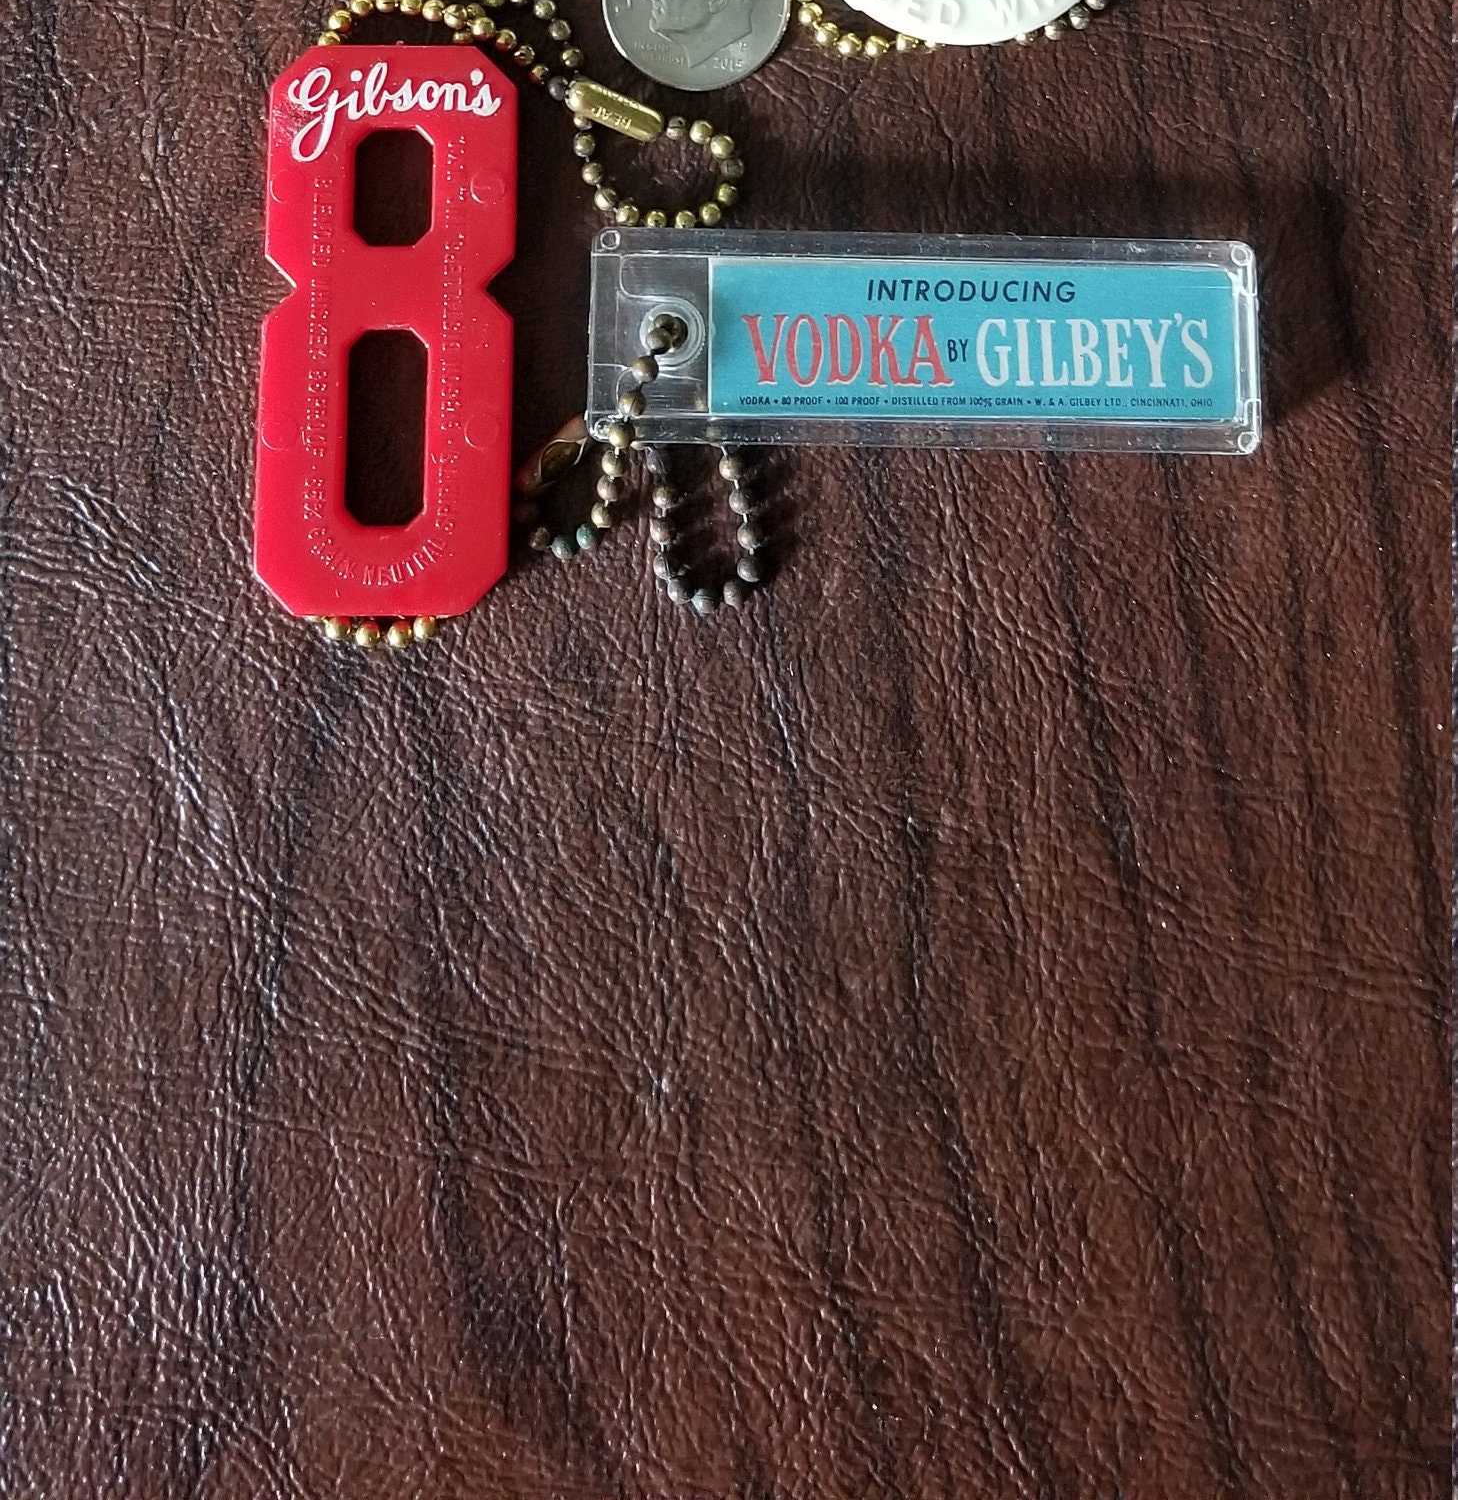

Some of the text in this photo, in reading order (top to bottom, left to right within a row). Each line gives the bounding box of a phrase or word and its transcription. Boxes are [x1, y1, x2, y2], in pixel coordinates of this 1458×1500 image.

[287, 61, 502, 163] Gibson's
[866, 278, 1078, 304] INTRODUCING
[741, 312, 1214, 389] VODKA BY GILBEY'S
[739, 396, 771, 406] VODKA
[781, 396, 792, 406] 80
[793, 396, 823, 406] PROOF
[835, 396, 849, 406] 100
[851, 396, 881, 406] PROOF
[891, 396, 938, 406] DISTILLED
[941, 396, 966, 406] FROM
[995, 397, 1023, 407] GRAIN
[1069, 397, 1101, 407] GILBEY
[1190, 397, 1213, 407] OHIO
[362, 537, 447, 586] NEUTRAL
